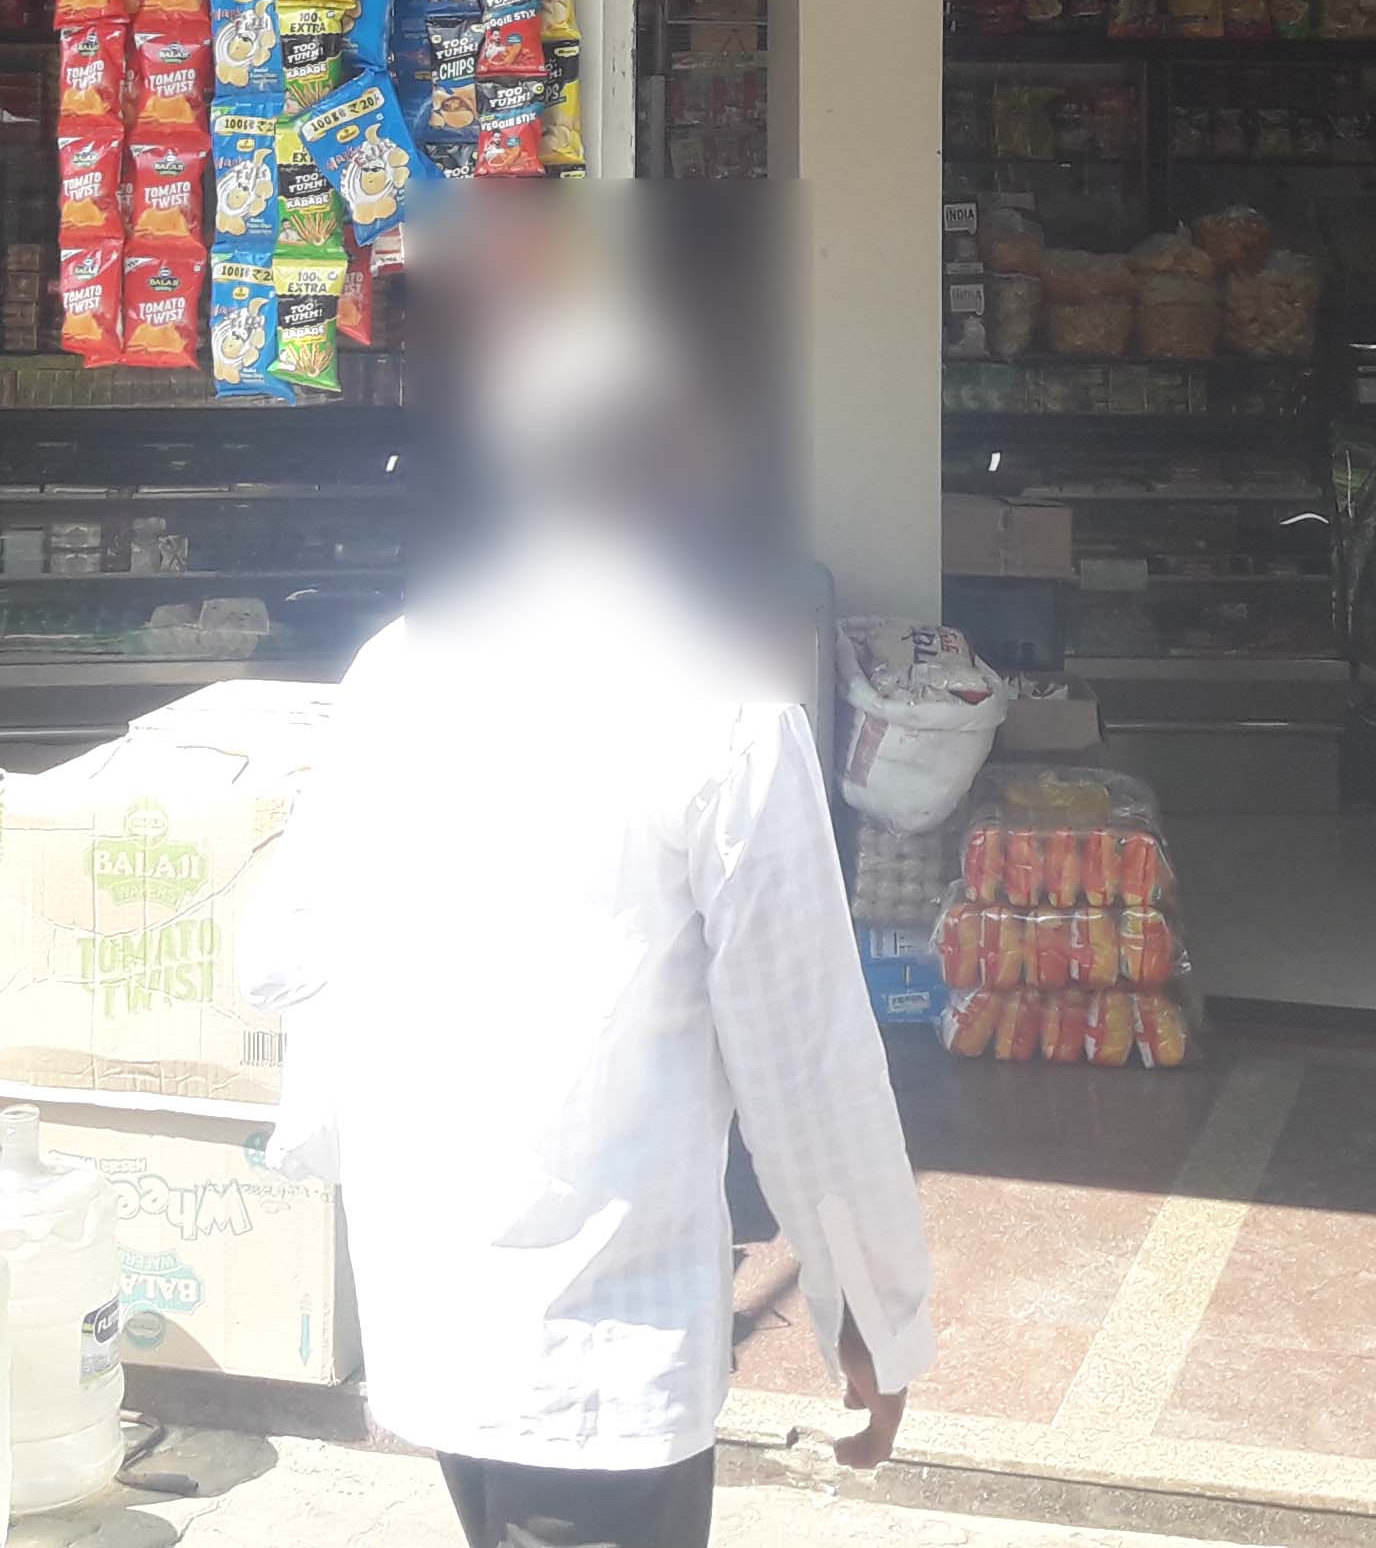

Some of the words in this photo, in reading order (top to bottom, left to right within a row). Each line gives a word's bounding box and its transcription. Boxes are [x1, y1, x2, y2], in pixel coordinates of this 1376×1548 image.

[513, 9, 536, 21] STIX
[290, 23, 326, 33] EXTRA
[292, 42, 317, 53] TOO
[435, 43, 479, 59] YUMM!
[442, 37, 469, 48] TOO
[66, 60, 105, 84] TOMATO
[439, 57, 475, 80] CHIPS
[72, 72, 104, 89] TWIST
[148, 68, 196, 90] TOMATO
[156, 80, 194, 97] TWIST
[497, 86, 523, 97] TOO
[489, 92, 531, 108] YUMM!
[480, 117, 514, 132] VEGGIE
[515, 112, 537, 124] STIX
[63, 171, 102, 196] TOMATO
[295, 172, 319, 183] TOO
[70, 184, 102, 200] TWIST
[144, 181, 191, 204] TOMATO
[151, 192, 190, 208] TWIST
[945, 208, 975, 221] INDIA
[287, 283, 328, 293] EXTRA
[63, 285, 102, 309] TOMATO
[69, 296, 102, 313] TWIST
[139, 297, 186, 319] TOMATO
[146, 309, 184, 324] TWIST
[290, 303, 314, 314] TOO
[94, 850, 200, 880] BALAJI
[77, 917, 222, 993] TOMATO
[103, 960, 215, 1020] TWIST
[107, 1173, 254, 1242] Whee
[121, 1251, 177, 1270] WAFER
[120, 1271, 201, 1303] BALA
